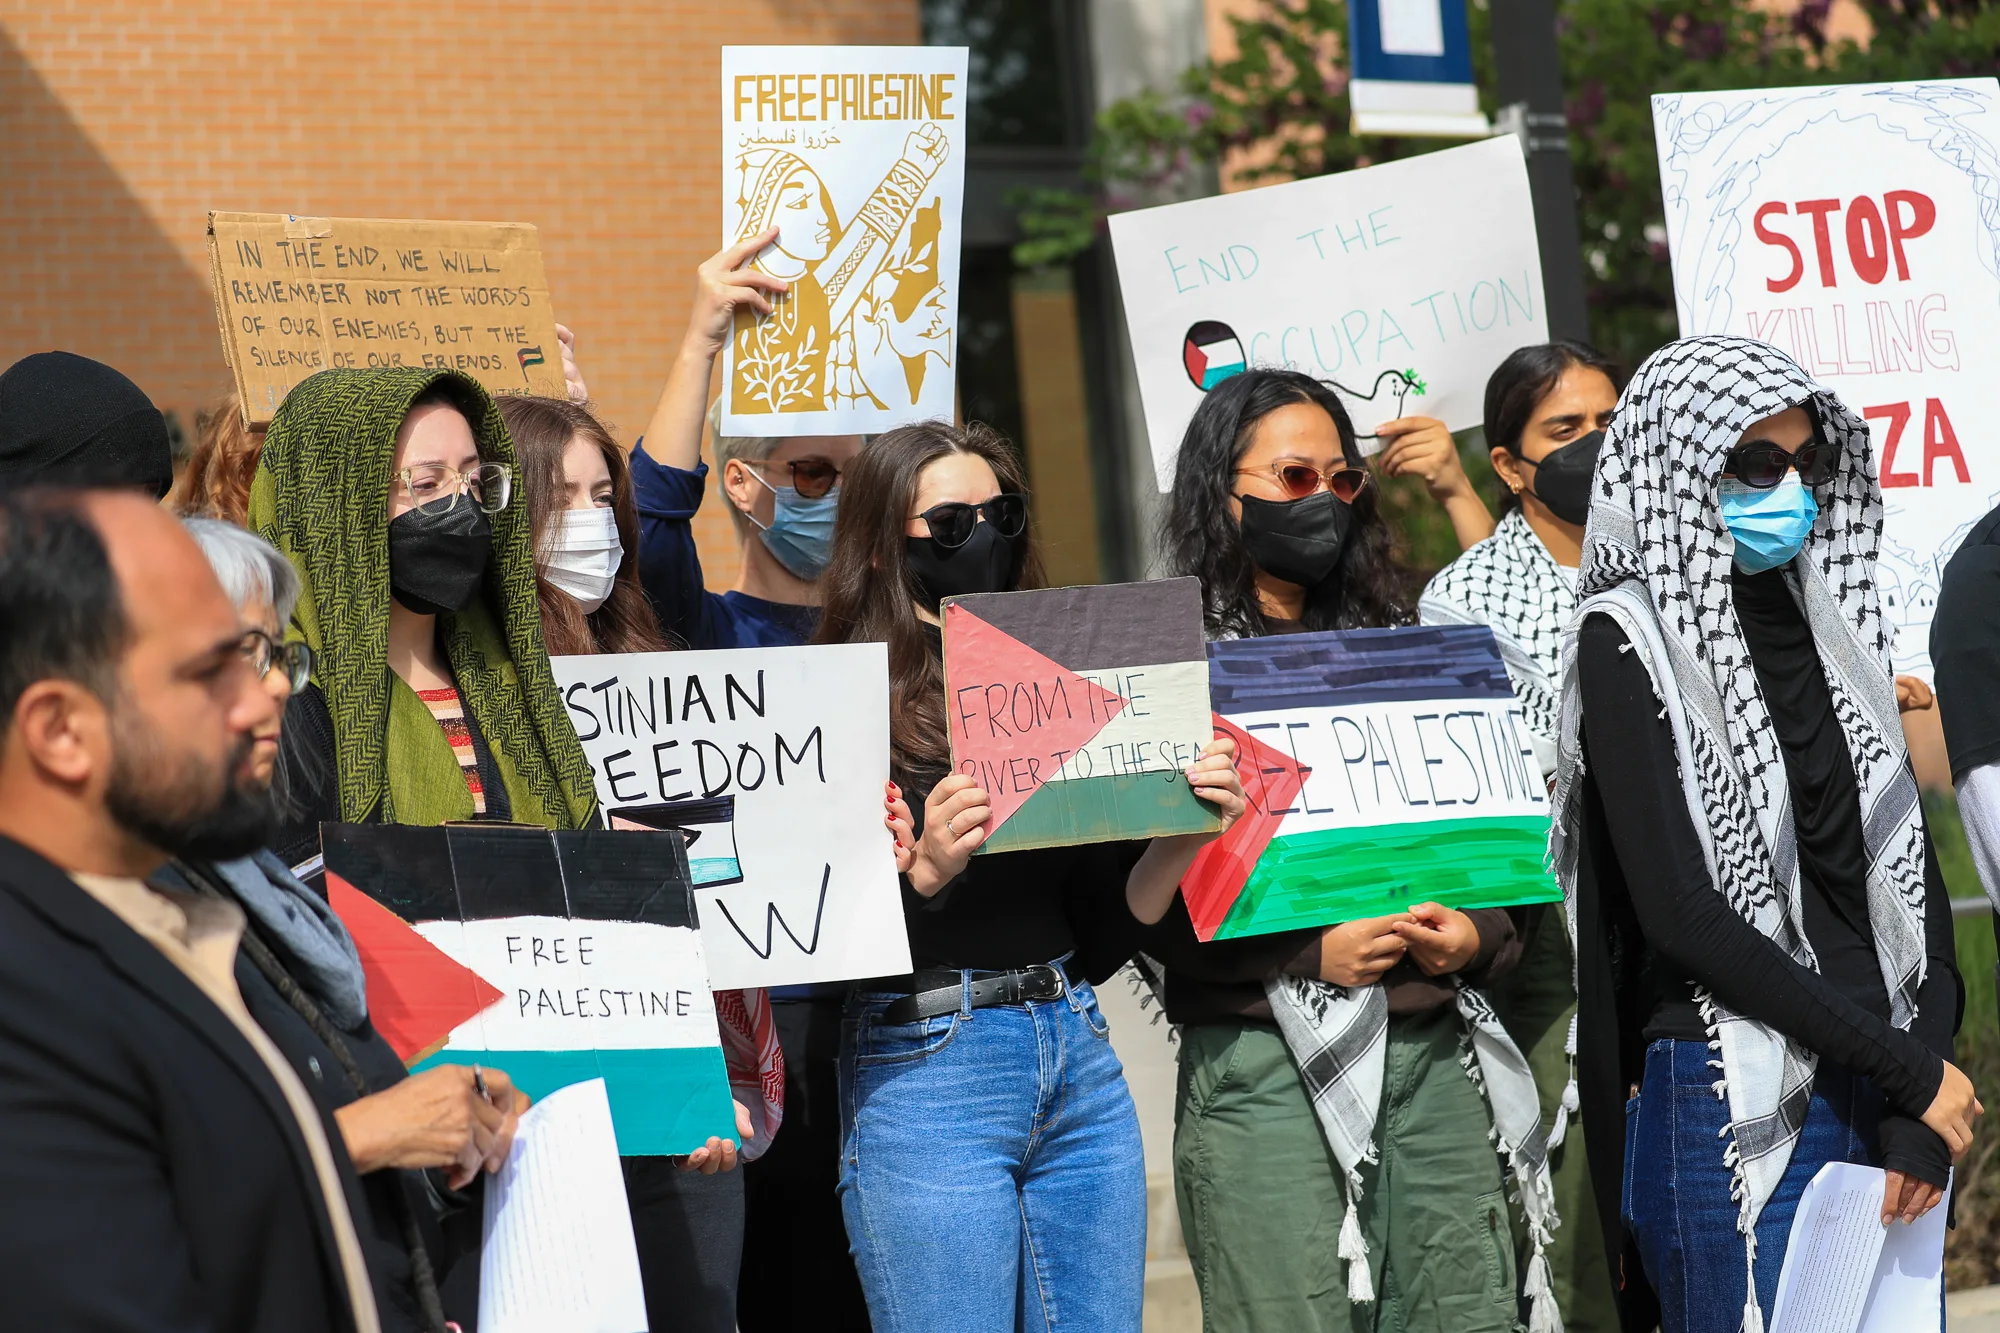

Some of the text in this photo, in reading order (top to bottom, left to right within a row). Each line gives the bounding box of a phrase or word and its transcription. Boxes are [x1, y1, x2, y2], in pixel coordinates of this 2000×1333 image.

[738, 126, 796, 150] فلسطين
[235, 240, 500, 274] IN THE END, WE WILL
[1164, 205, 1401, 294] END THE
[1752, 190, 1936, 294] STOP
[232, 280, 530, 307] REMEMBER NOT THE WORDS
[242, 315, 529, 346] OF OUR ENEMIES, BUT THE
[250, 347, 507, 370] SILENCE OF OUR FRIENDS.
[490, 388, 533, 396] UTHER
[1862, 397, 1972, 489] ZA
[558, 669, 765, 741] STINIAN
[957, 673, 1150, 739] FROM THE
[590, 726, 826, 803] EEDOM
[1051, 748, 1093, 785] TO
[1102, 741, 1155, 783] THE
[1331, 709, 1543, 814] PALESTINE
[506, 936, 595, 967] FREE
[518, 987, 692, 1019] PALESTINE
